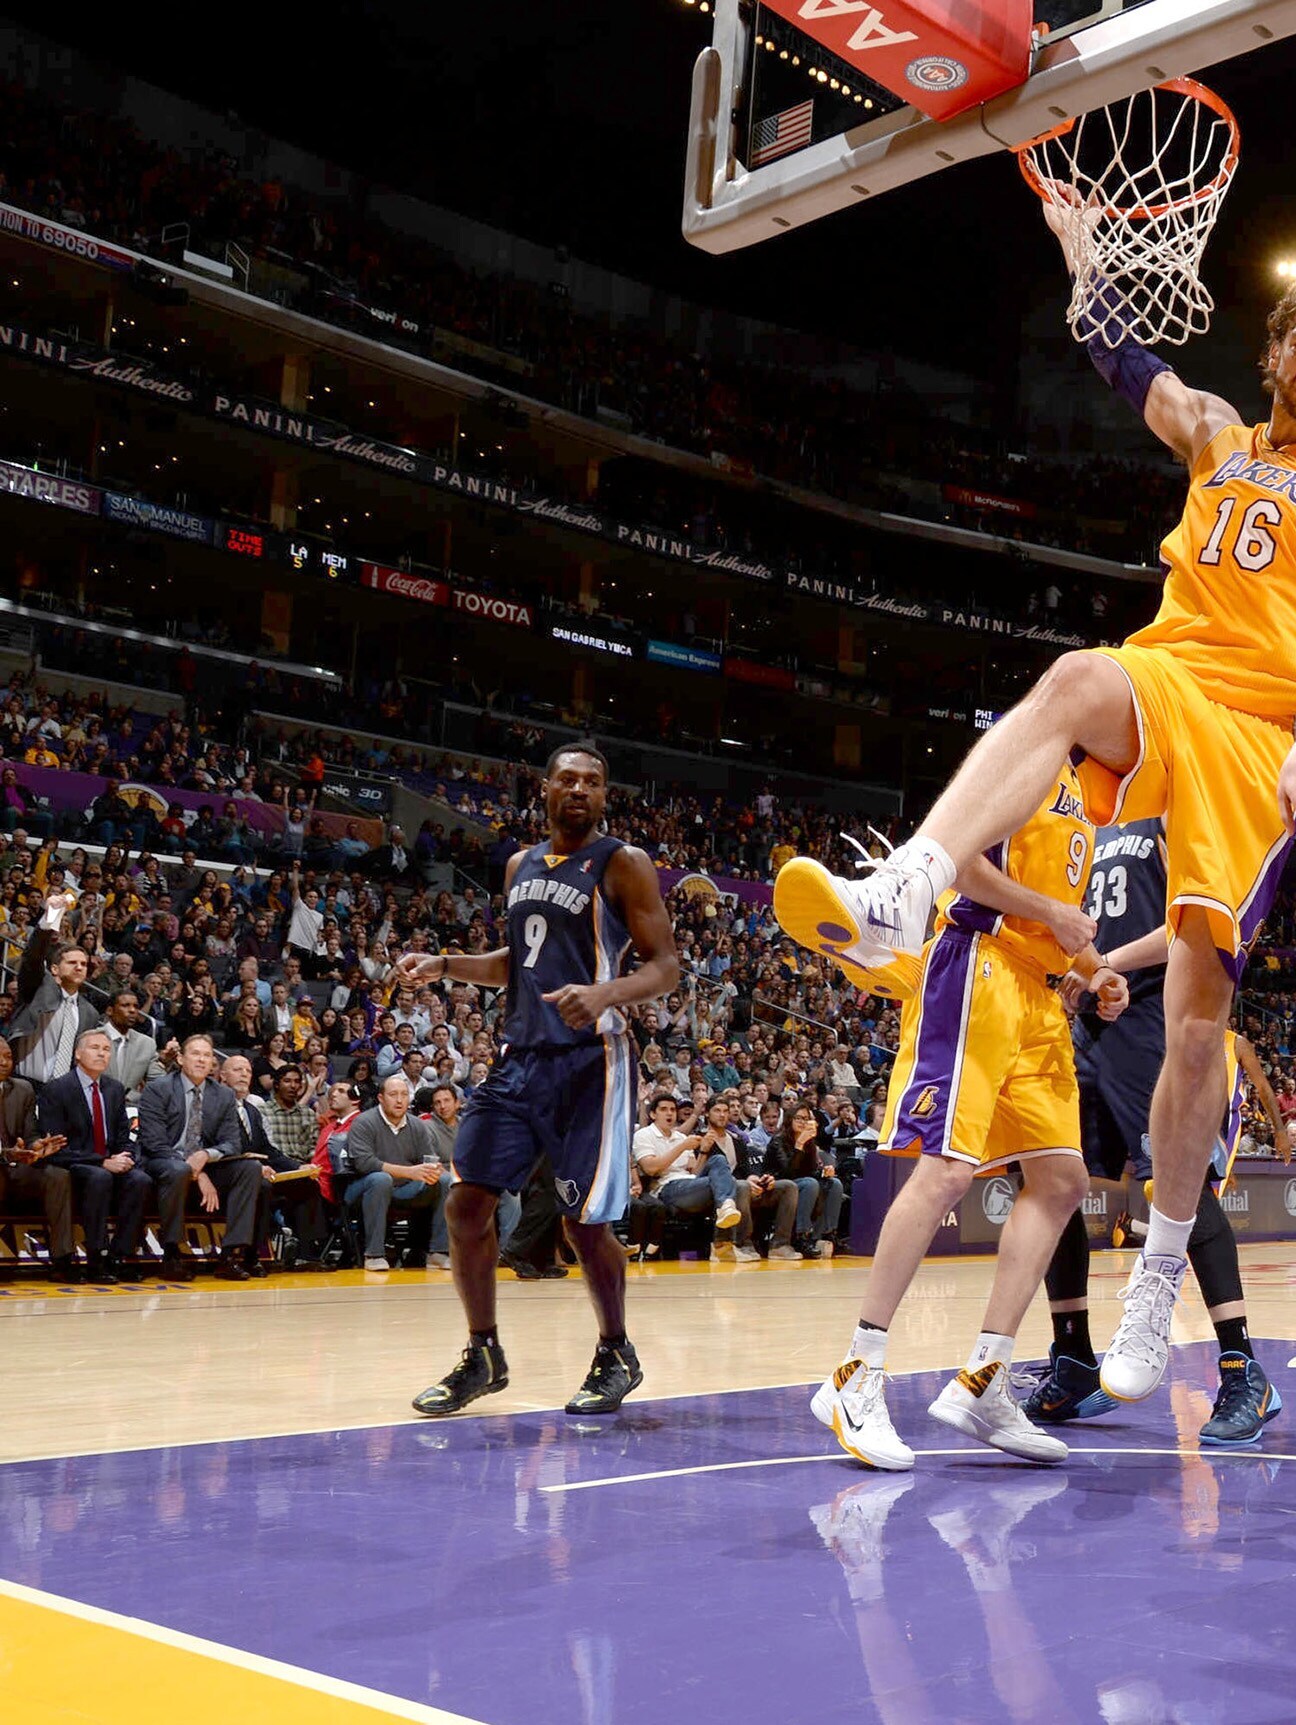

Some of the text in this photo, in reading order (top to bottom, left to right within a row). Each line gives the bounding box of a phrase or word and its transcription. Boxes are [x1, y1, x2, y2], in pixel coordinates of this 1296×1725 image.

[26, 216, 40, 239] TO
[42, 226, 99, 260] 69050
[68, 356, 193, 401] Authentic
[214, 396, 417, 473] PANINI Authentic
[110, 496, 141, 516] SAN
[150, 505, 207, 533] MANUEL
[434, 466, 602, 532] PANINI Authentic
[290, 543, 347, 570] LA MEM
[617, 525, 773, 580] PANINI Authentic
[1198, 497, 1282, 572] 16
[452, 589, 532, 626] TOYOTA
[787, 572, 929, 619] PANINI Authentic
[552, 626, 571, 641] SAN
[942, 609, 1013, 635] PANINI
[1012, 624, 1087, 647] Authentic
[975, 709, 994, 720] PHI
[1066, 831, 1088, 888] 9
[1092, 834, 1154, 865] EMPHIS
[507, 878, 590, 915] MEMPHIS
[1088, 865, 1128, 922] 33
[523, 913, 548, 969] 9
